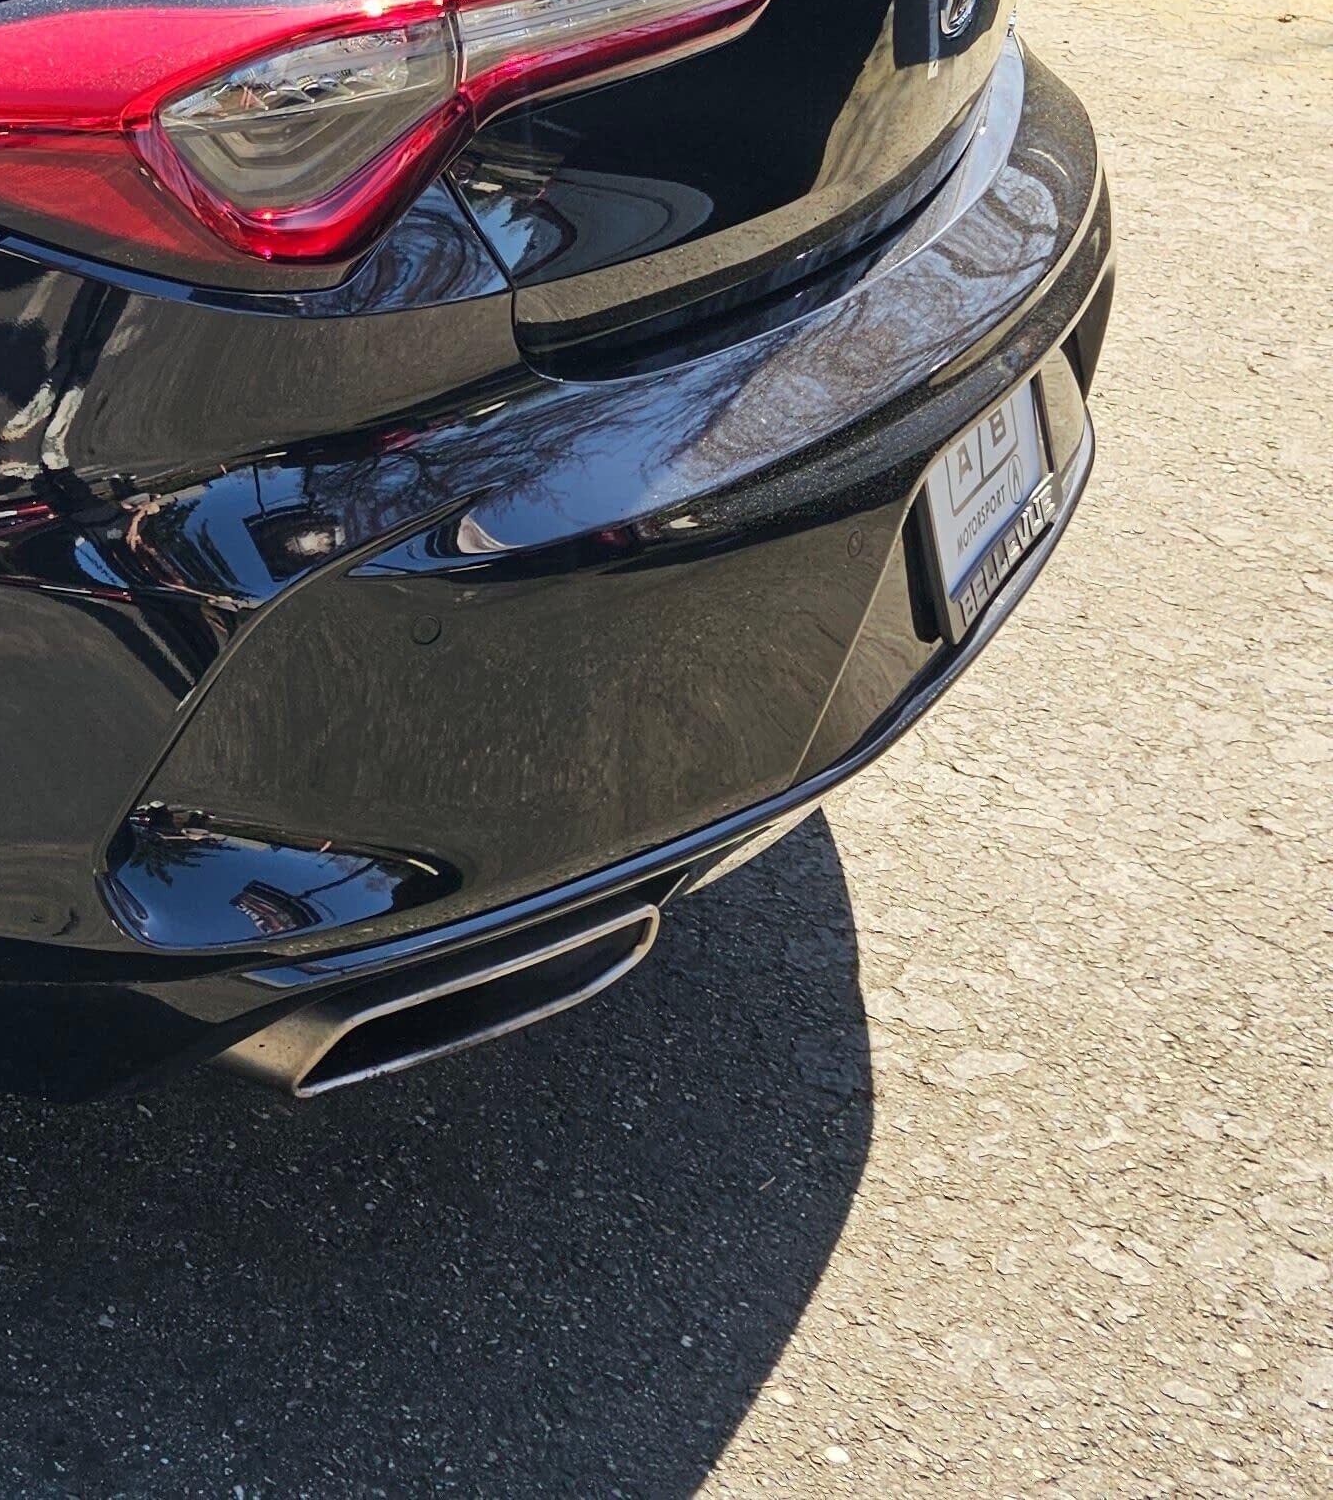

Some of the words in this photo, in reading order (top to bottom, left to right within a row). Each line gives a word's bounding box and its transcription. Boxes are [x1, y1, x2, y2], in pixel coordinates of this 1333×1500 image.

[957, 442, 973, 484] A
[987, 407, 1007, 448] B
[957, 484, 1006, 556] MOTORSPORT
[959, 484, 1056, 627] BELLEVUE
